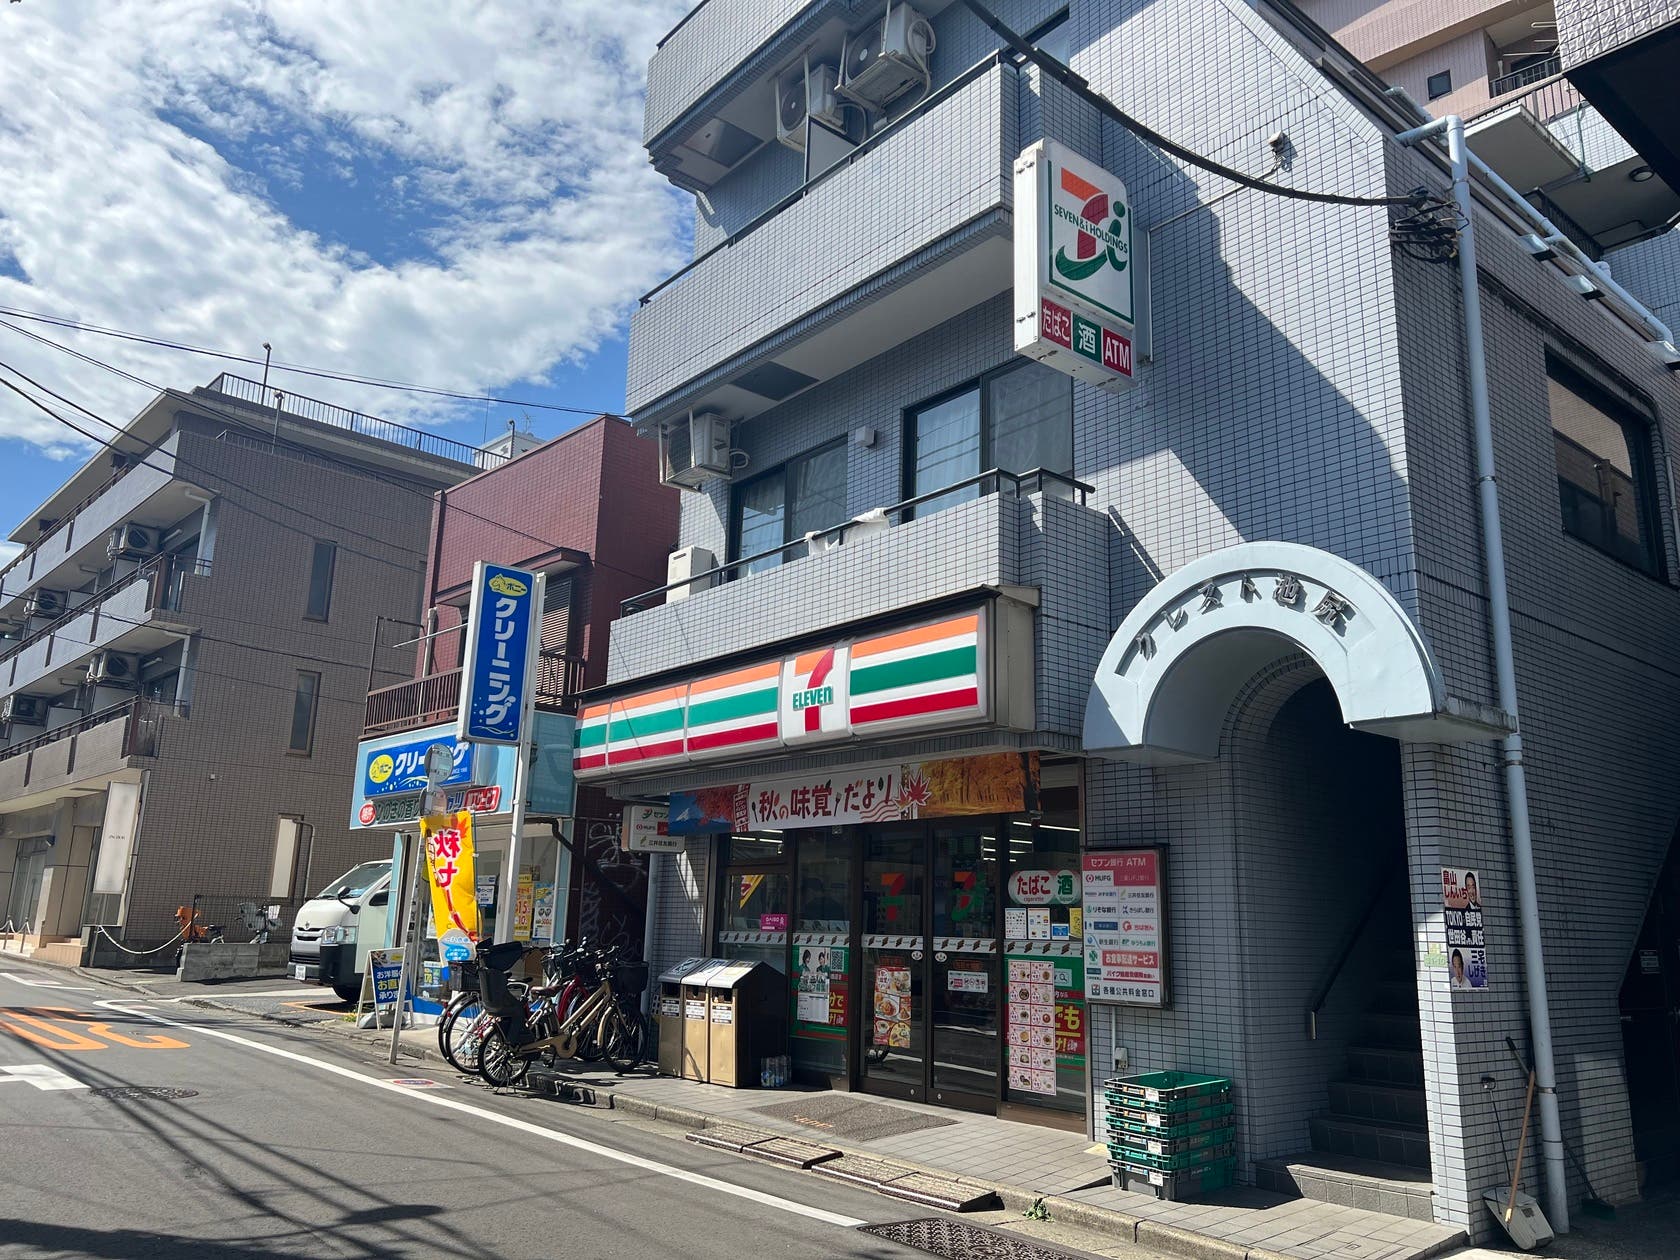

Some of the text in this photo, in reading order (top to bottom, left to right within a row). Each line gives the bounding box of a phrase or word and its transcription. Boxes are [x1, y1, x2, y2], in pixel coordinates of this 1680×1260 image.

[1089, 225, 1128, 254] HOLDINGS
[1042, 306, 1070, 342] たばこ
[1078, 322, 1096, 354] 酒
[1104, 336, 1130, 371] ATM
[485, 597, 518, 726] クリーニング
[395, 742, 470, 776] クリーグ
[1091, 857, 1147, 867] セブン銀行 ATM
[1017, 874, 1051, 895] たばこ
[1057, 874, 1073, 895] 酒
[1095, 874, 1111, 882] MUFG
[377, 978, 400, 991] お直
[1103, 986, 1155, 998] 各種公共料金窓口
